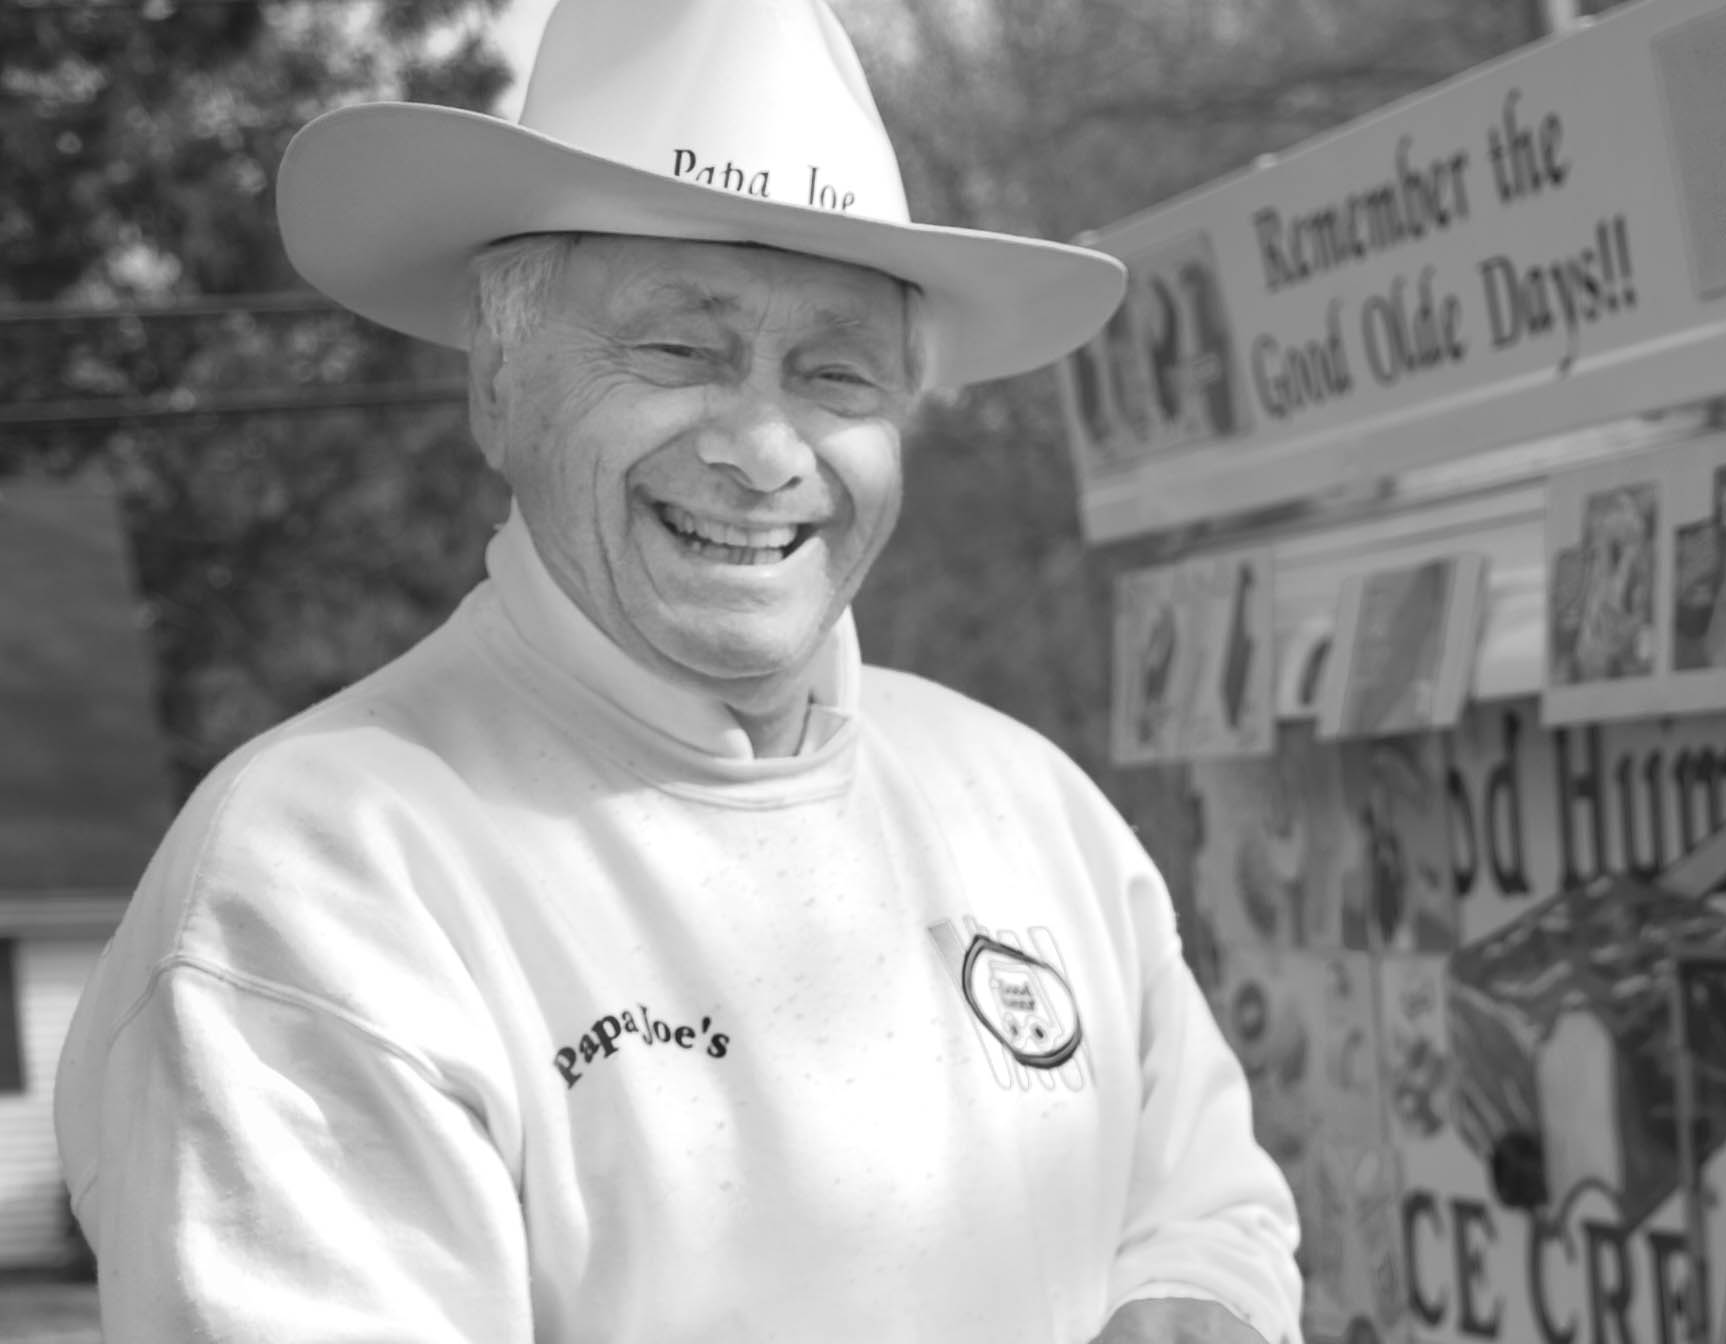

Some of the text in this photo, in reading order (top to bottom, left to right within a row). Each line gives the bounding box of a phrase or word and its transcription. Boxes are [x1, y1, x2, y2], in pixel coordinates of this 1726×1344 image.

[1252, 87, 1572, 294] Remember the
[1250, 213, 1638, 420] Good Olde Days!!
[1402, 1191, 1507, 1341] CE
